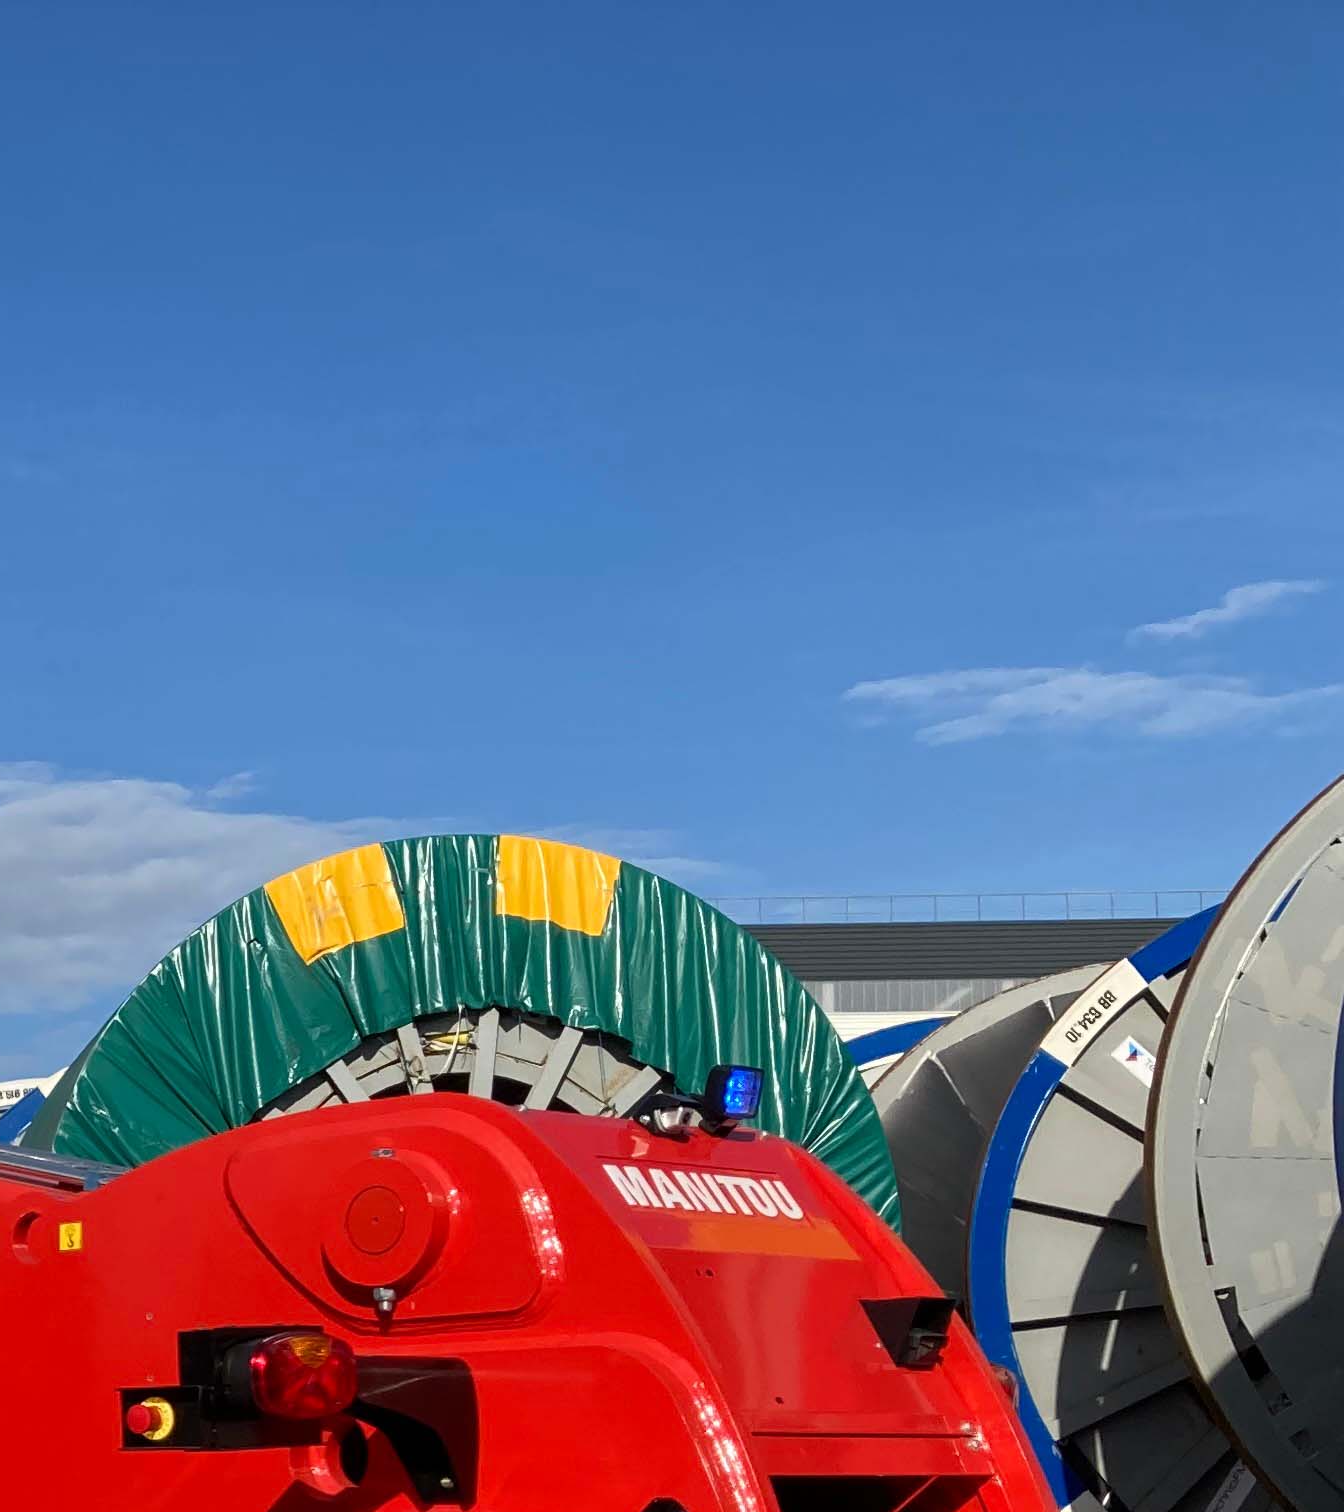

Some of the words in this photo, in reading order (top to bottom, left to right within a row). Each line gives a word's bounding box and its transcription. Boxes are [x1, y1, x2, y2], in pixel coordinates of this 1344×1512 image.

[1098, 989, 1119, 1010] BB
[1064, 1006, 1103, 1044] 634.10
[601, 1163, 804, 1220] MANITOU
